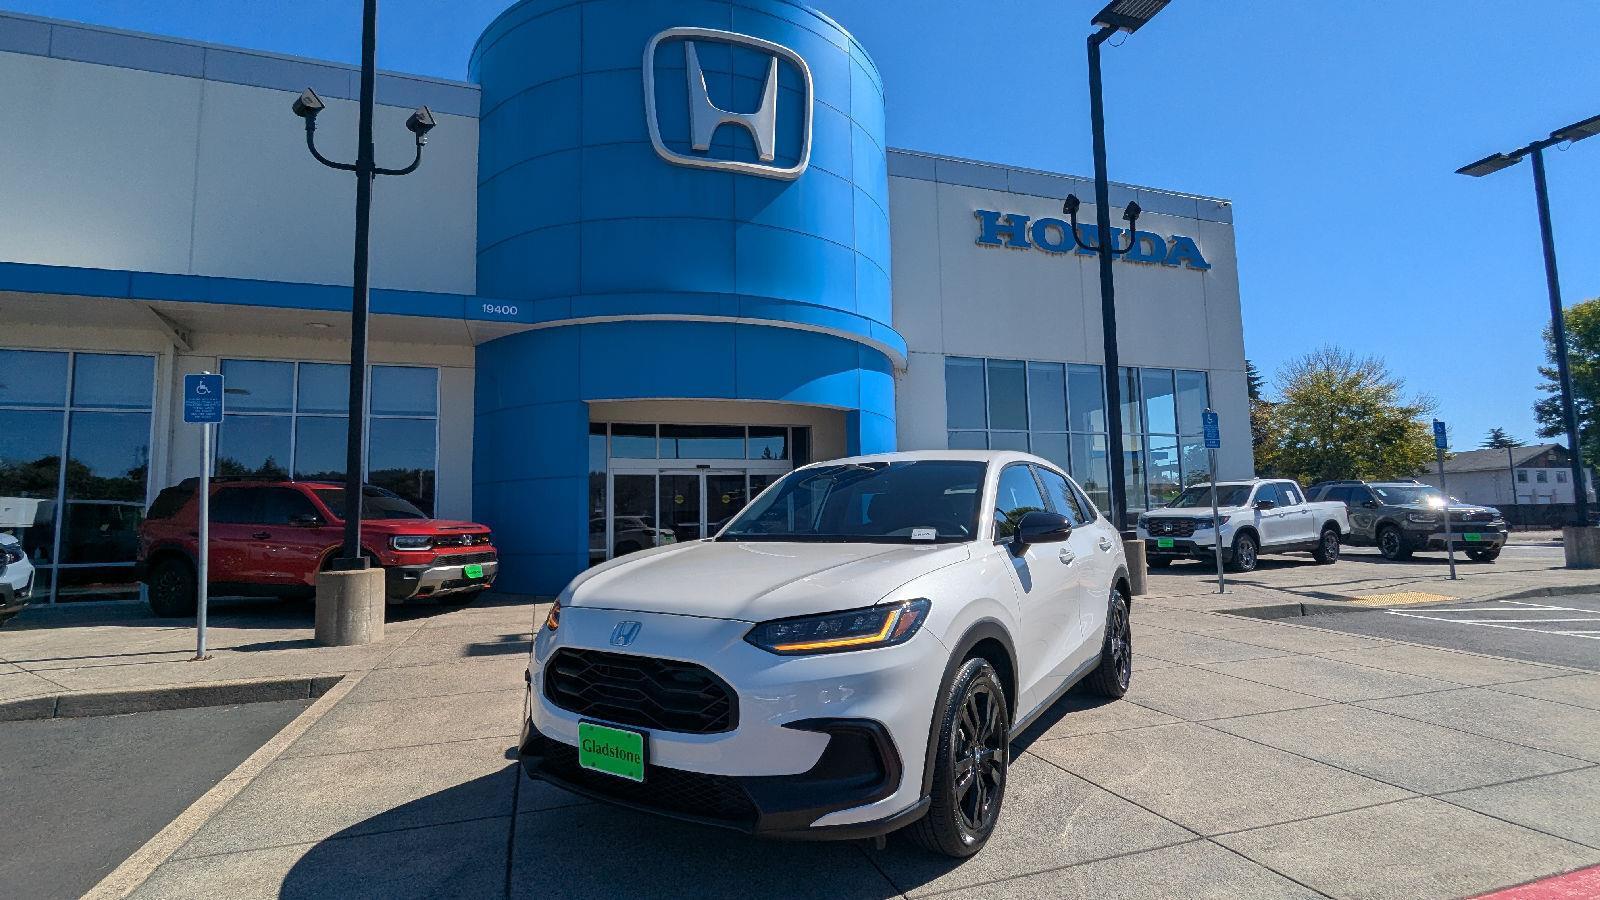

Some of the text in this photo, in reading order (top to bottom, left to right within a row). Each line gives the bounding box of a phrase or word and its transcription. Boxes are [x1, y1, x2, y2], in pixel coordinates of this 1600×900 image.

[975, 209, 1211, 271] HONDA
[482, 303, 518, 315] 19400
[582, 738, 641, 764] Gladstone
